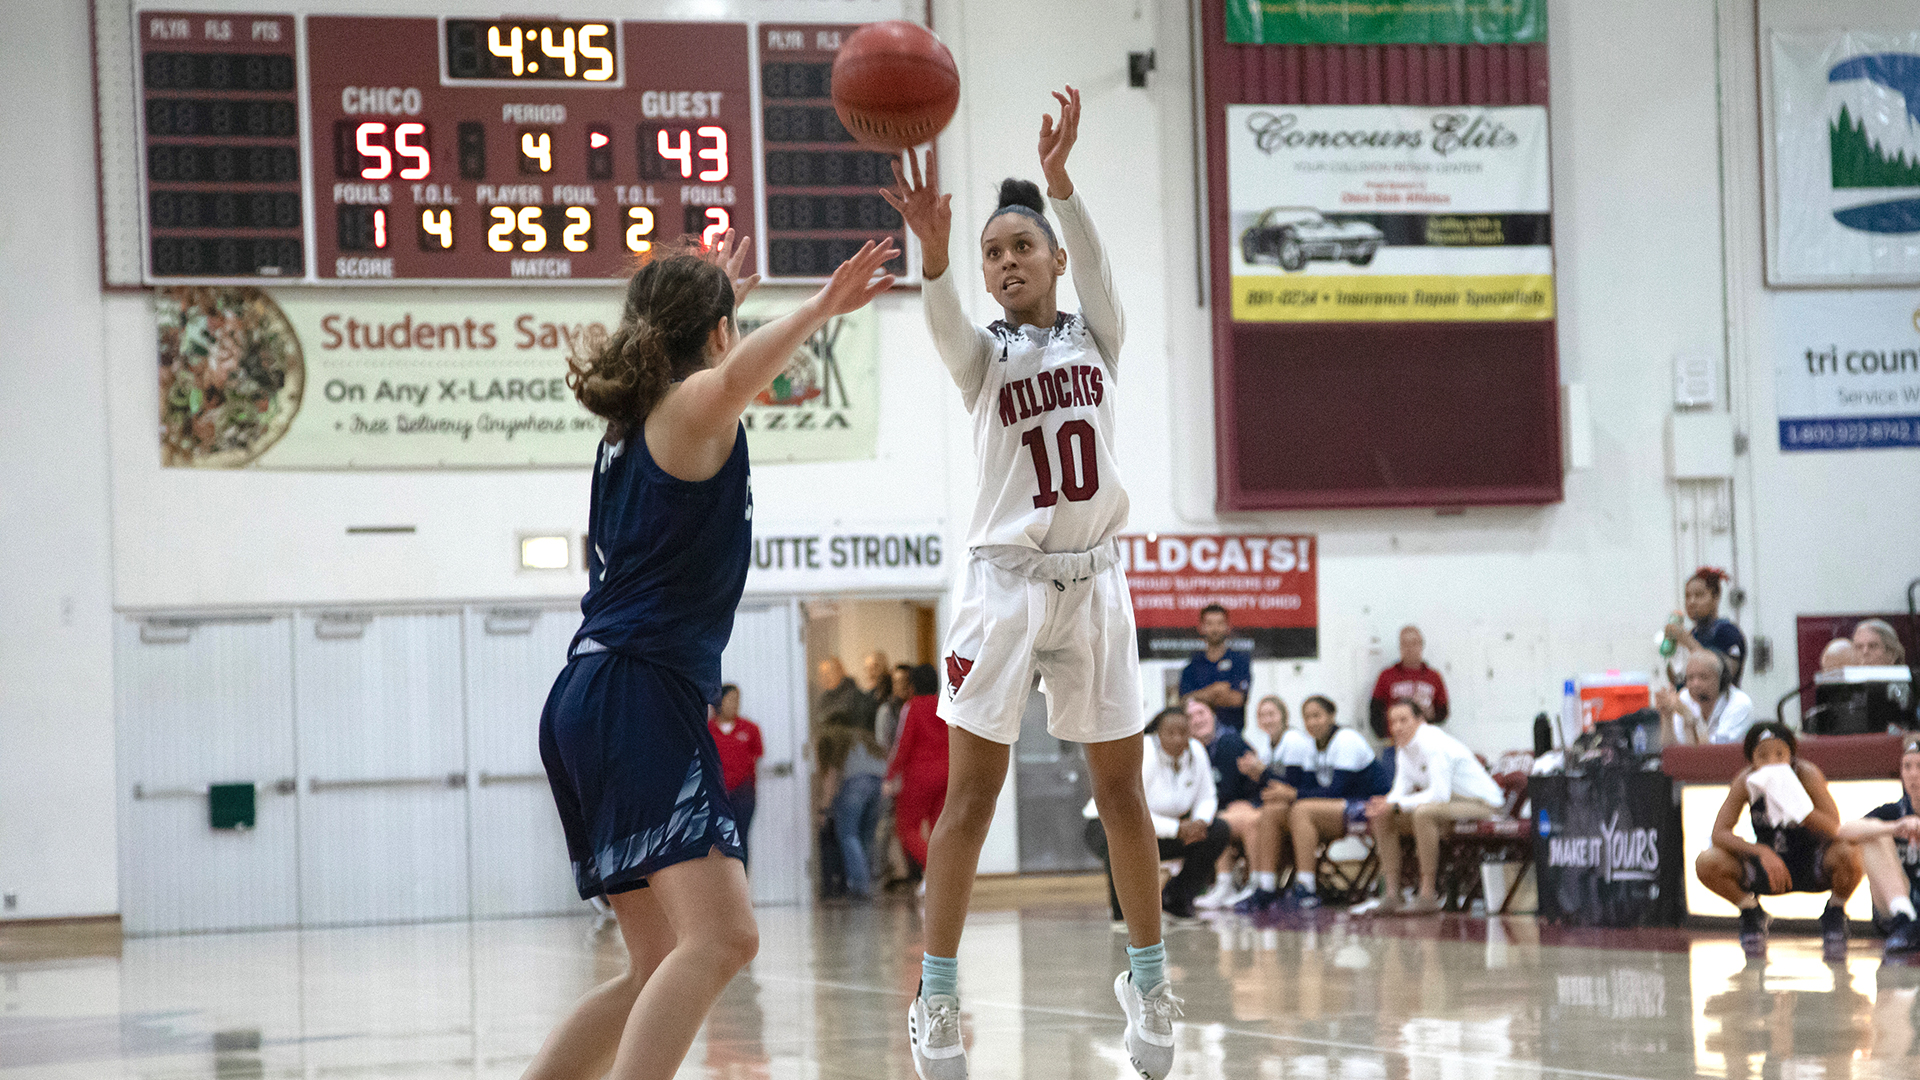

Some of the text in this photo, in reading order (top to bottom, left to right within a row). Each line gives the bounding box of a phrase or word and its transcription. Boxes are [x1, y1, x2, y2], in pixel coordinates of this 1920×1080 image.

[488, 24, 613, 80] 4:45
[341, 86, 422, 115] CHICO
[503, 103, 567, 123] PERIOD
[641, 90, 722, 118] GUEST
[356, 122, 431, 180] 55
[521, 132, 552, 172] 4
[1246, 111, 1422, 156] Concours
[658, 126, 729, 181] 43
[333, 183, 392, 204] FOULS
[476, 184, 597, 205] PLAYER FOUL
[680, 185, 736, 205] FOULS
[373, 209, 387, 248] 1
[422, 209, 453, 249] 4
[488, 206, 547, 252] 25
[563, 206, 591, 252] 2
[626, 206, 654, 252] 2
[703, 207, 730, 252] 2
[335, 257, 394, 278] SCORE
[511, 258, 571, 278] MATCH
[321, 313, 497, 350] Students
[1805, 344, 1920, 375] tri coun
[325, 378, 564, 407] On Any X-LARGE
[999, 365, 1104, 427] WILDCATS
[744, 412, 850, 431] IZZA
[1022, 419, 1100, 509] 10
[753, 533, 943, 570] UTTE STRONG
[1119, 538, 1310, 572] ILDCATS!
[1549, 810, 1660, 885] MAKE IT YOURS
